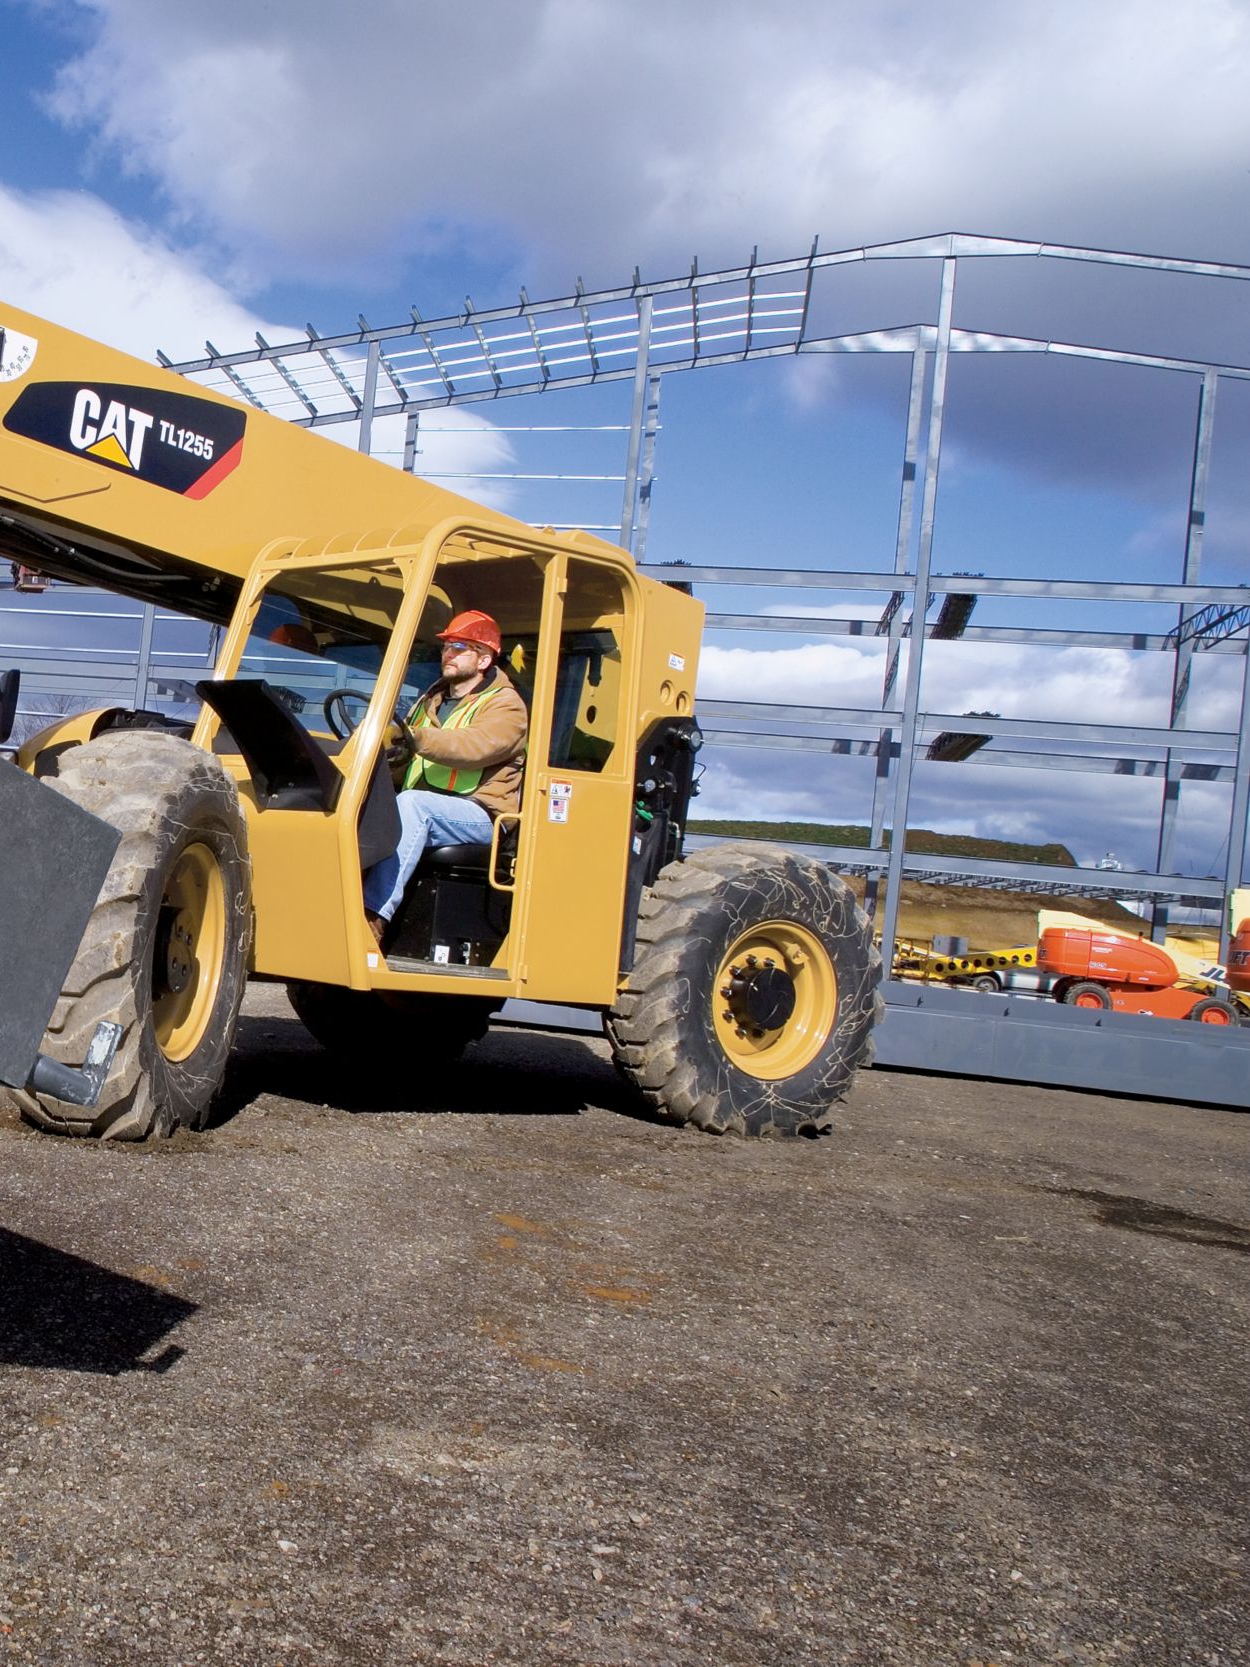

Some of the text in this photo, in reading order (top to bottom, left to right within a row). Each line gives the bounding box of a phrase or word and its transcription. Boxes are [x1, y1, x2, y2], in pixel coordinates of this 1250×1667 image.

[69, 388, 214, 471] CAT TL1255
[1199, 967, 1226, 981] JL
